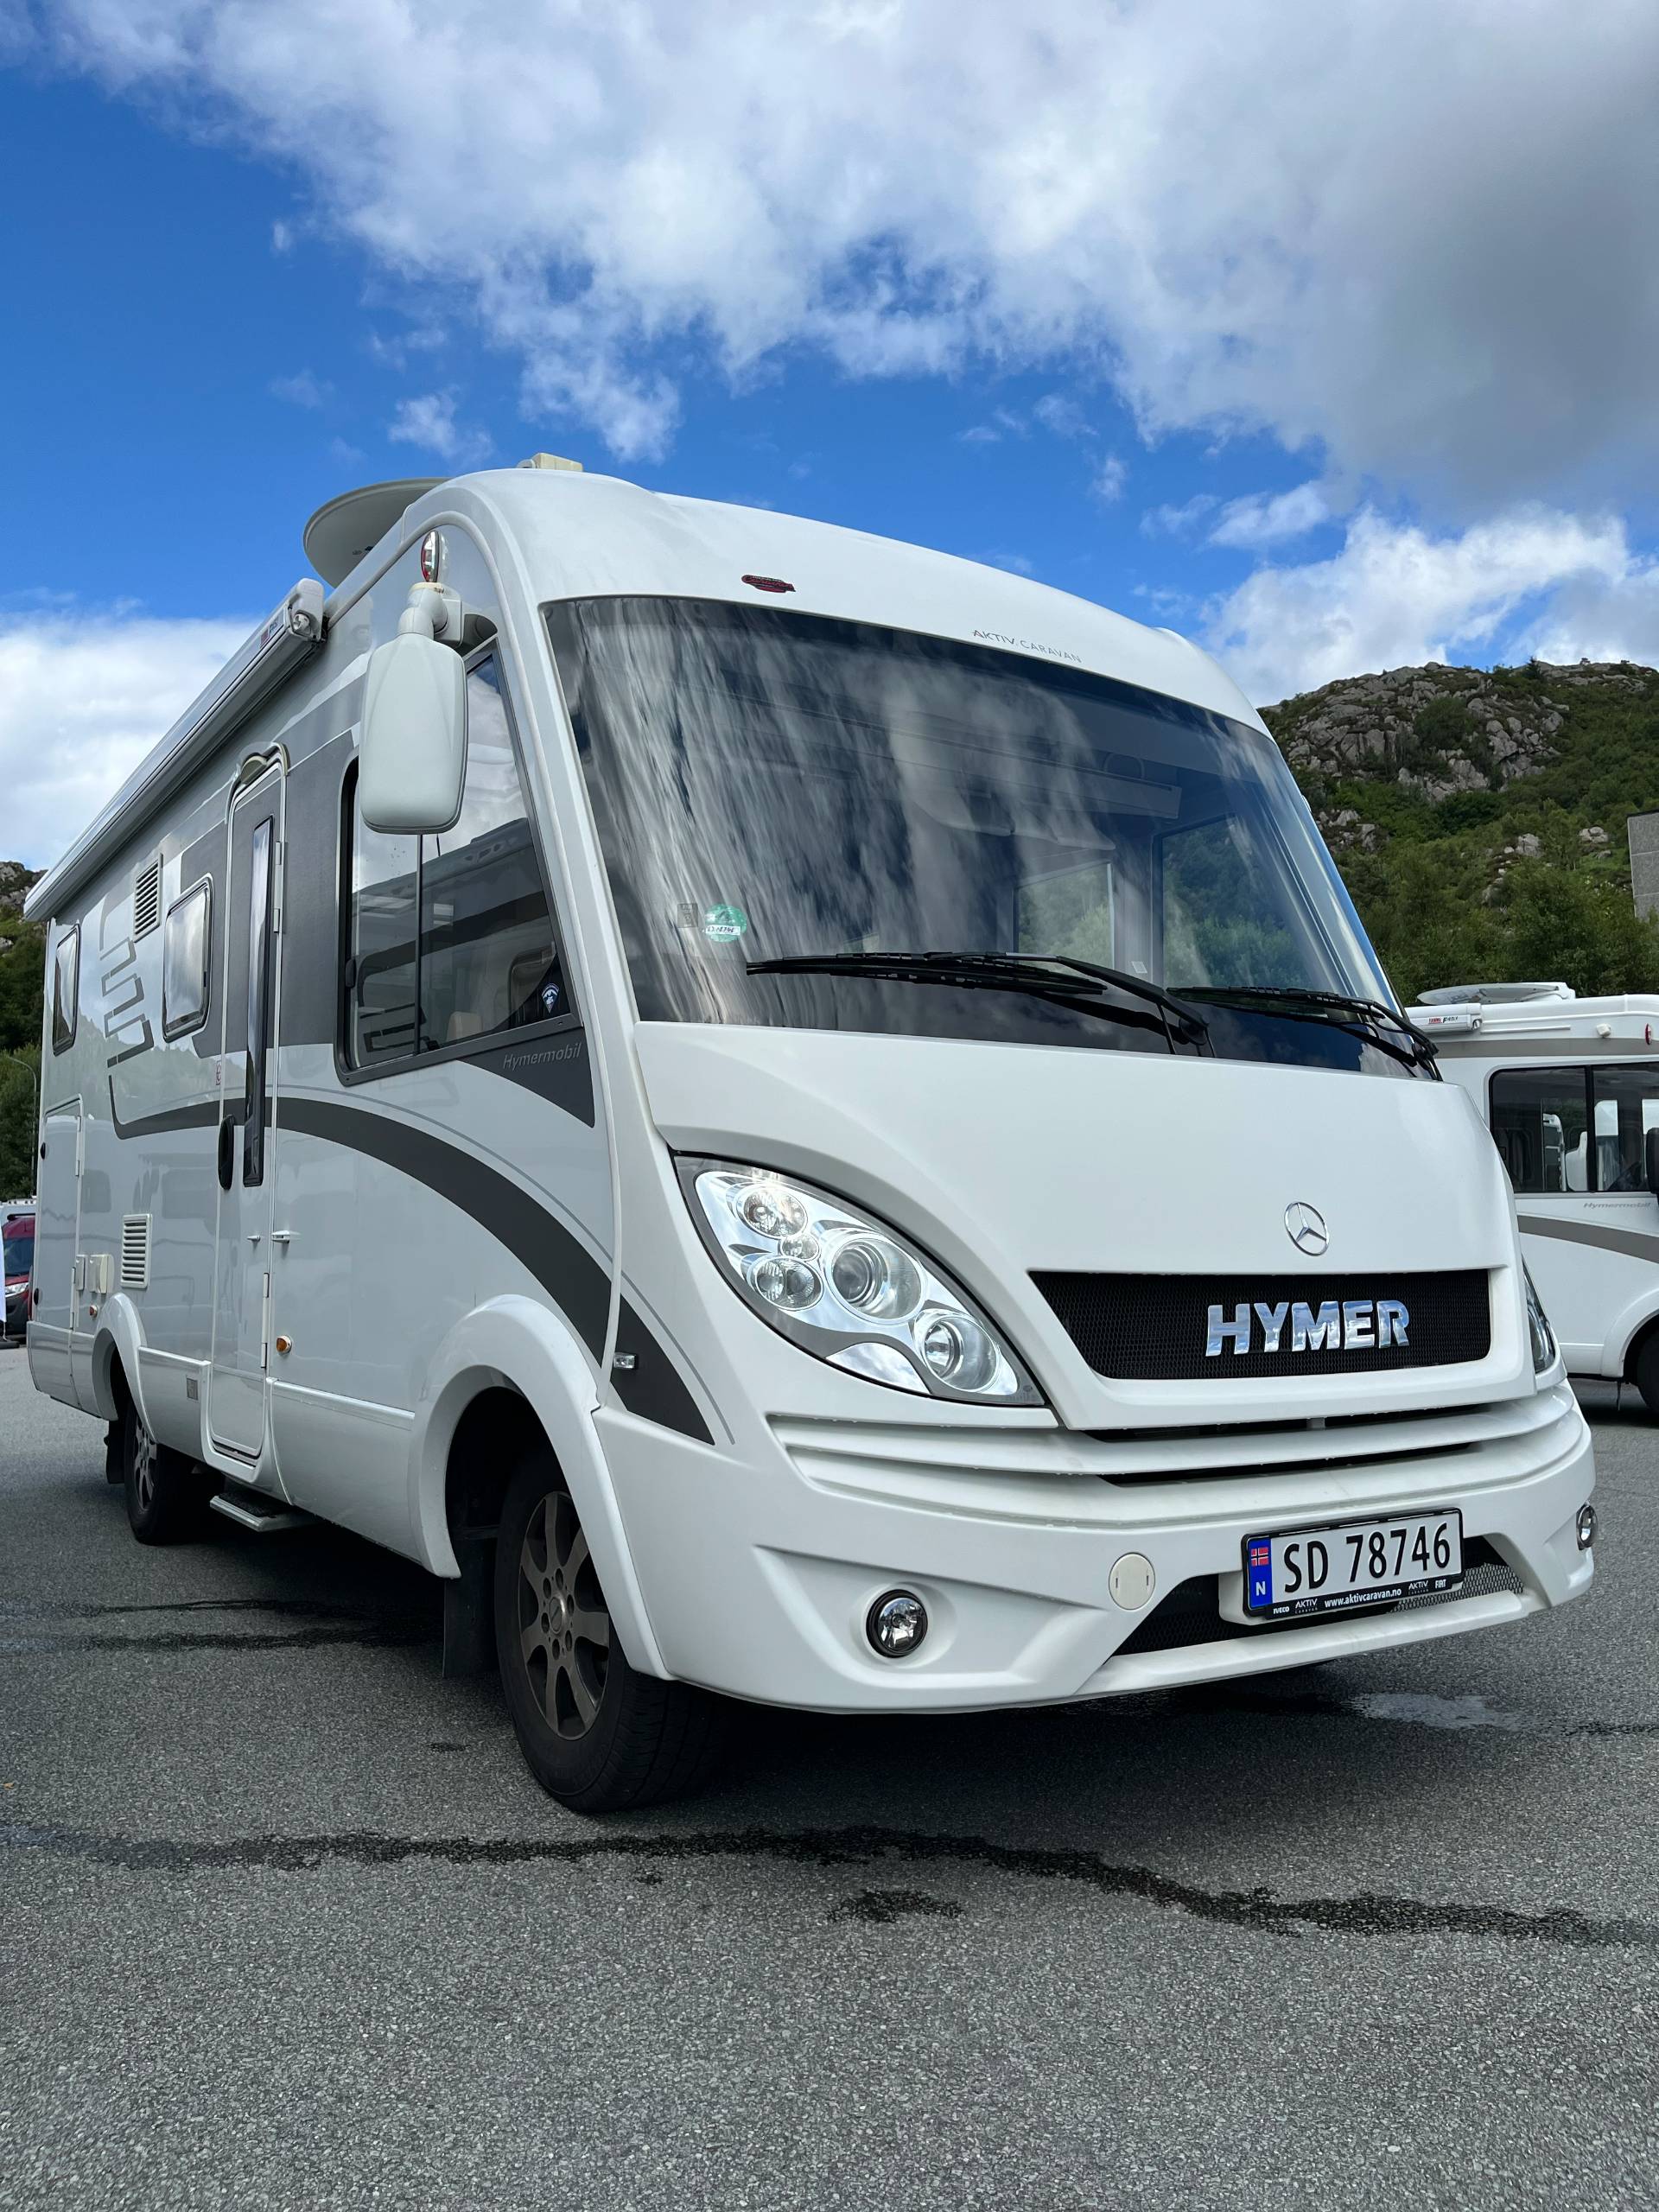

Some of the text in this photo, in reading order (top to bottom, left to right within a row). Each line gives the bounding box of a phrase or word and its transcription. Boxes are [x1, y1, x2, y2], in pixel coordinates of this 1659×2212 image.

[972, 629, 1082, 663] AKTIV CARAVAN
[502, 1042, 582, 1071] Hymermobil
[1205, 1300, 1410, 1357] HYMER
[1283, 1522, 1451, 1593] SD 78746
[1255, 1580, 1266, 1596] N
[1294, 1598, 1318, 1609] AKTIV
[1324, 1588, 1402, 1608] www.aktivcaravan.no
[1408, 1580, 1429, 1590] AKTIV
